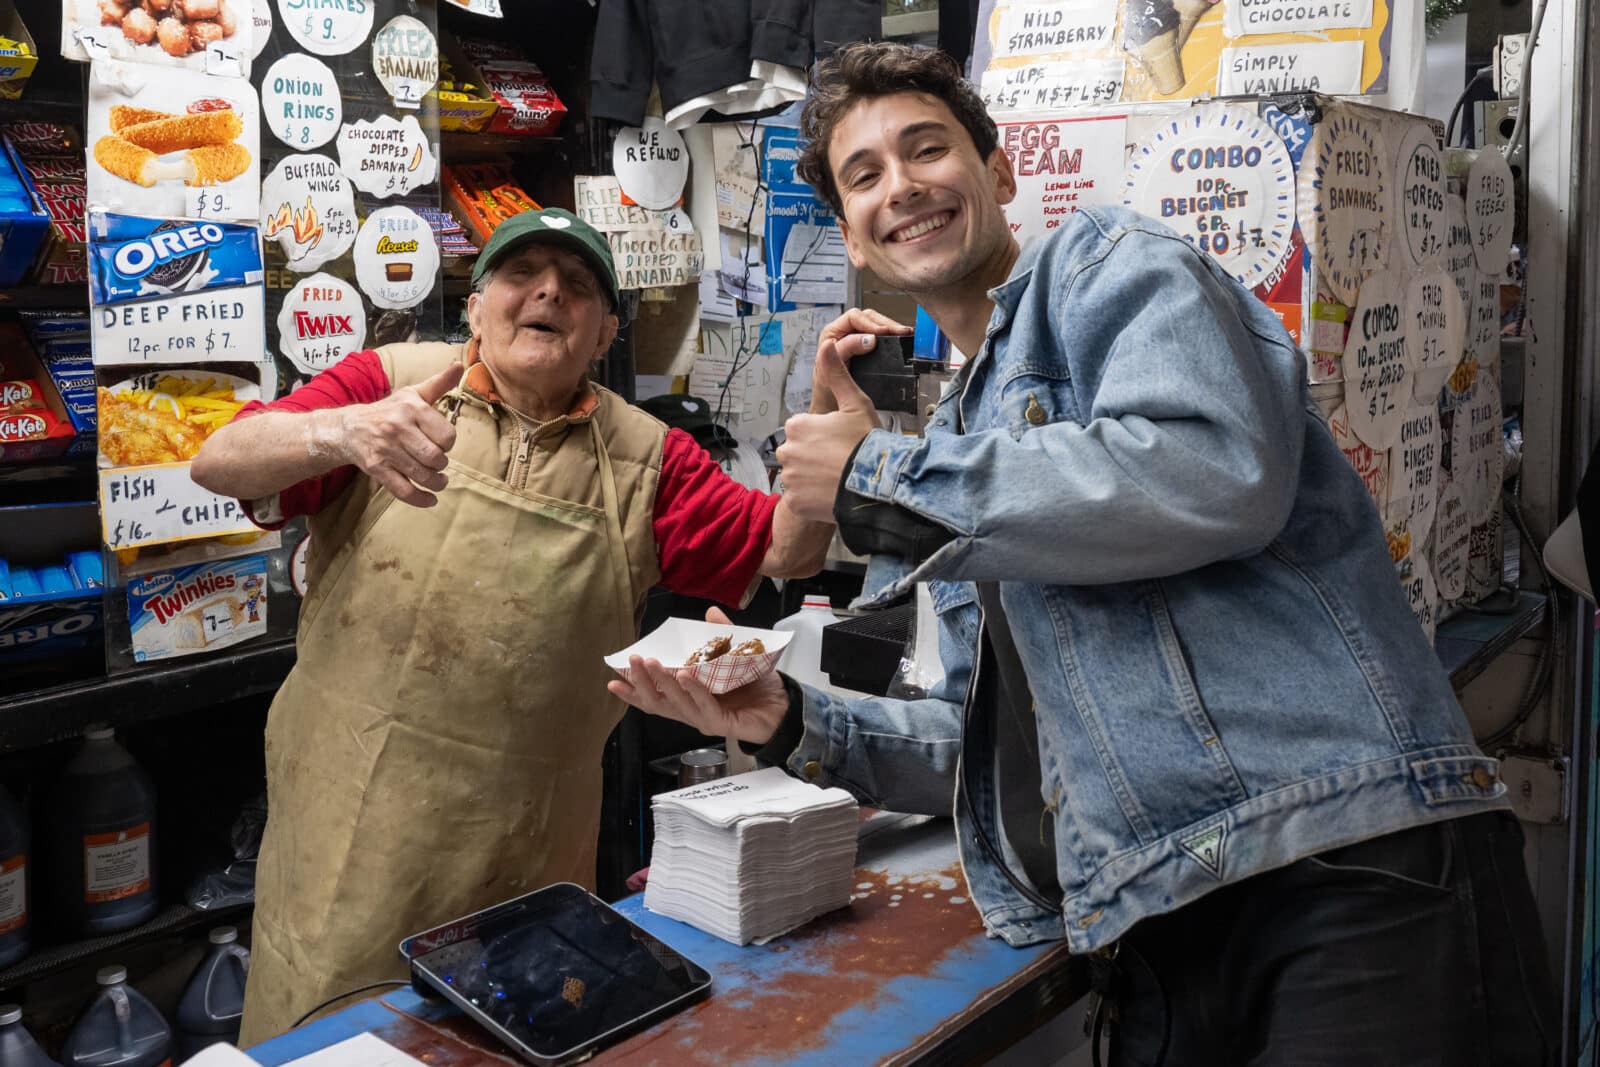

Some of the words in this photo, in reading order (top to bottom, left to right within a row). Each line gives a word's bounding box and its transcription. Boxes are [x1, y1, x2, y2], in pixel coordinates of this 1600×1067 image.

[1249, 4, 1352, 24] CHOCOLATE
[1233, 52, 1297, 72] SIMPLY
[274, 77, 323, 97] ONION
[1244, 72, 1320, 94] VANILLA
[283, 100, 335, 121] RINGS
[348, 129, 405, 143] CHOCOLATE
[639, 131, 659, 147] WE
[1004, 125, 1061, 151] EGG
[369, 144, 408, 157] DIPPED
[626, 147, 680, 162] REFUND
[1170, 144, 1262, 174] COMBO
[285, 162, 335, 181] BUFFALO
[360, 158, 405, 174] BANANA
[1336, 151, 1371, 177] FRIED
[1415, 154, 1440, 182] FRIED
[308, 179, 341, 193] WINGS
[1160, 190, 1249, 218] BEIGNET
[1329, 186, 1378, 212] BANANAS
[114, 223, 224, 276] OREO
[303, 288, 343, 302] FRIED
[103, 305, 169, 328] DEEP
[182, 300, 244, 322] FRIED
[1363, 303, 1399, 341] COMBO
[168, 336, 196, 350] FOR
[1401, 415, 1433, 443] CHICKEN
[110, 476, 156, 503] FISH
[144, 571, 237, 625] Twinkies
[1407, 577, 1423, 604] ISH
